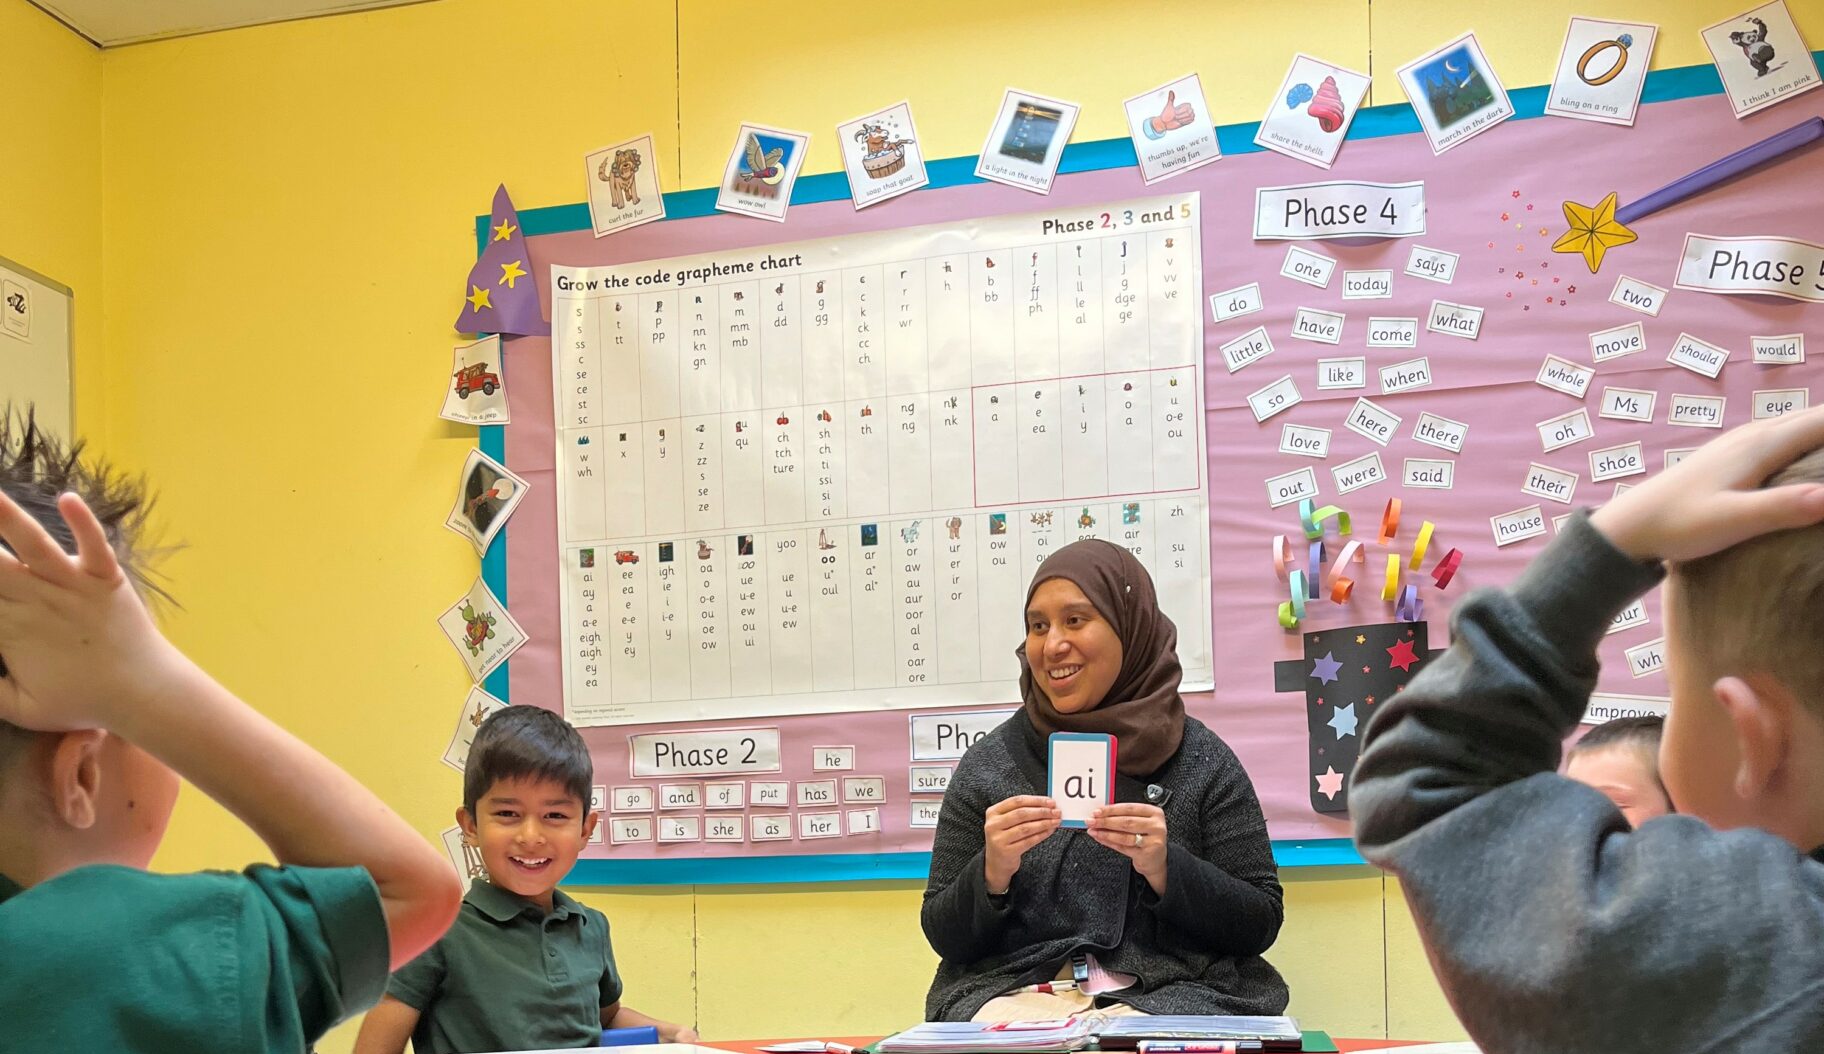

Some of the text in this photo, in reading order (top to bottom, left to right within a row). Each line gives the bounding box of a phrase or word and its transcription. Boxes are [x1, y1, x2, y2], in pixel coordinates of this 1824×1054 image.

[1748, 91, 1770, 104] think
[1794, 74, 1811, 87] pink
[1560, 96, 1580, 109] bling
[1602, 105, 1618, 114] ring
[1438, 130, 1462, 145] march
[1472, 117, 1485, 128] the
[1486, 107, 1503, 120] dark
[1271, 132, 1323, 156] share the shells
[1148, 149, 1175, 162] thumbs
[1161, 151, 1200, 169] having fun
[898, 175, 913, 186] goat
[1017, 171, 1029, 180] the
[1030, 175, 1048, 185] night
[633, 209, 643, 218] fur
[1043, 203, 1190, 235] Phase 2, 3 and 5
[1284, 197, 1398, 228] Phase 4
[558, 254, 802, 290] Grow the code grapheme chart
[1294, 260, 1321, 279] one
[1415, 256, 1446, 278] says
[1708, 249, 1805, 286] Phase
[1347, 276, 1389, 295] today
[985, 291, 998, 302] bb
[1115, 293, 1135, 307] dge
[1622, 287, 1653, 309] two
[1029, 302, 1042, 317] ph
[1228, 295, 1248, 313] do
[774, 316, 787, 327] dd
[816, 314, 828, 326] gg
[1299, 316, 1335, 337] have
[1436, 312, 1475, 332] what
[731, 324, 750, 332] mm
[653, 332, 665, 344] pp
[1372, 328, 1412, 342] come
[576, 341, 585, 349] ss
[1595, 335, 1640, 356] move
[1756, 343, 1797, 357] would
[859, 353, 871, 364] ch
[1230, 340, 1264, 364] little
[1679, 344, 1719, 366] should
[694, 359, 706, 370] gn
[1328, 367, 1355, 382] like
[1384, 369, 1427, 388] when
[1547, 366, 1585, 387] whole
[1268, 393, 1285, 409] so
[1614, 396, 1639, 413] Ms
[1675, 404, 1717, 422] pretty
[1766, 401, 1792, 415] eye
[945, 415, 958, 426] nk
[1355, 409, 1389, 437] here
[819, 428, 830, 439] sh
[902, 422, 915, 433] ng
[1033, 425, 1046, 433] ea
[1168, 430, 1182, 438] ou
[1419, 421, 1460, 446] there
[1555, 424, 1577, 442] oh
[736, 439, 748, 450] qu
[1290, 432, 1321, 450] love
[776, 448, 791, 458] tch
[774, 465, 794, 473] ture
[1598, 453, 1637, 473] shoe
[577, 466, 592, 477] wh
[1340, 465, 1377, 487] were
[1411, 468, 1444, 483] said
[1279, 480, 1305, 499] out
[1531, 474, 1567, 495] their
[1171, 505, 1184, 516] zh
[1498, 514, 1542, 536] house
[1125, 531, 1140, 539] air
[777, 540, 796, 552] yoo
[1038, 538, 1048, 546] oi
[1172, 544, 1184, 552] su
[822, 556, 835, 564] oo
[659, 565, 674, 580] igh
[700, 565, 712, 573] oa
[905, 564, 920, 572] aw
[583, 572, 593, 582] ai
[822, 584, 838, 595] oul
[905, 595, 923, 604] aur
[741, 608, 755, 616] ew
[782, 605, 797, 613] u-e
[906, 611, 923, 619] oor
[1610, 607, 1638, 625] our
[583, 619, 597, 627] a-e
[580, 631, 601, 645] eigh
[580, 646, 602, 661] aigh
[625, 647, 635, 658] ey
[909, 674, 925, 682] ore
[655, 738, 756, 767] Phase 2
[826, 753, 840, 766] he
[918, 777, 946, 787] sure
[1065, 768, 1096, 798] ai
[669, 790, 695, 804] and
[720, 789, 730, 803] of
[761, 789, 778, 801] put
[805, 787, 827, 800] has
[855, 788, 873, 796] we
[627, 796, 640, 807] go
[920, 808, 940, 819] the
[811, 820, 831, 832] her
[866, 815, 870, 828] I
[626, 827, 639, 837] to
[675, 824, 685, 836] is
[713, 822, 734, 835] she
[766, 825, 779, 834] as
